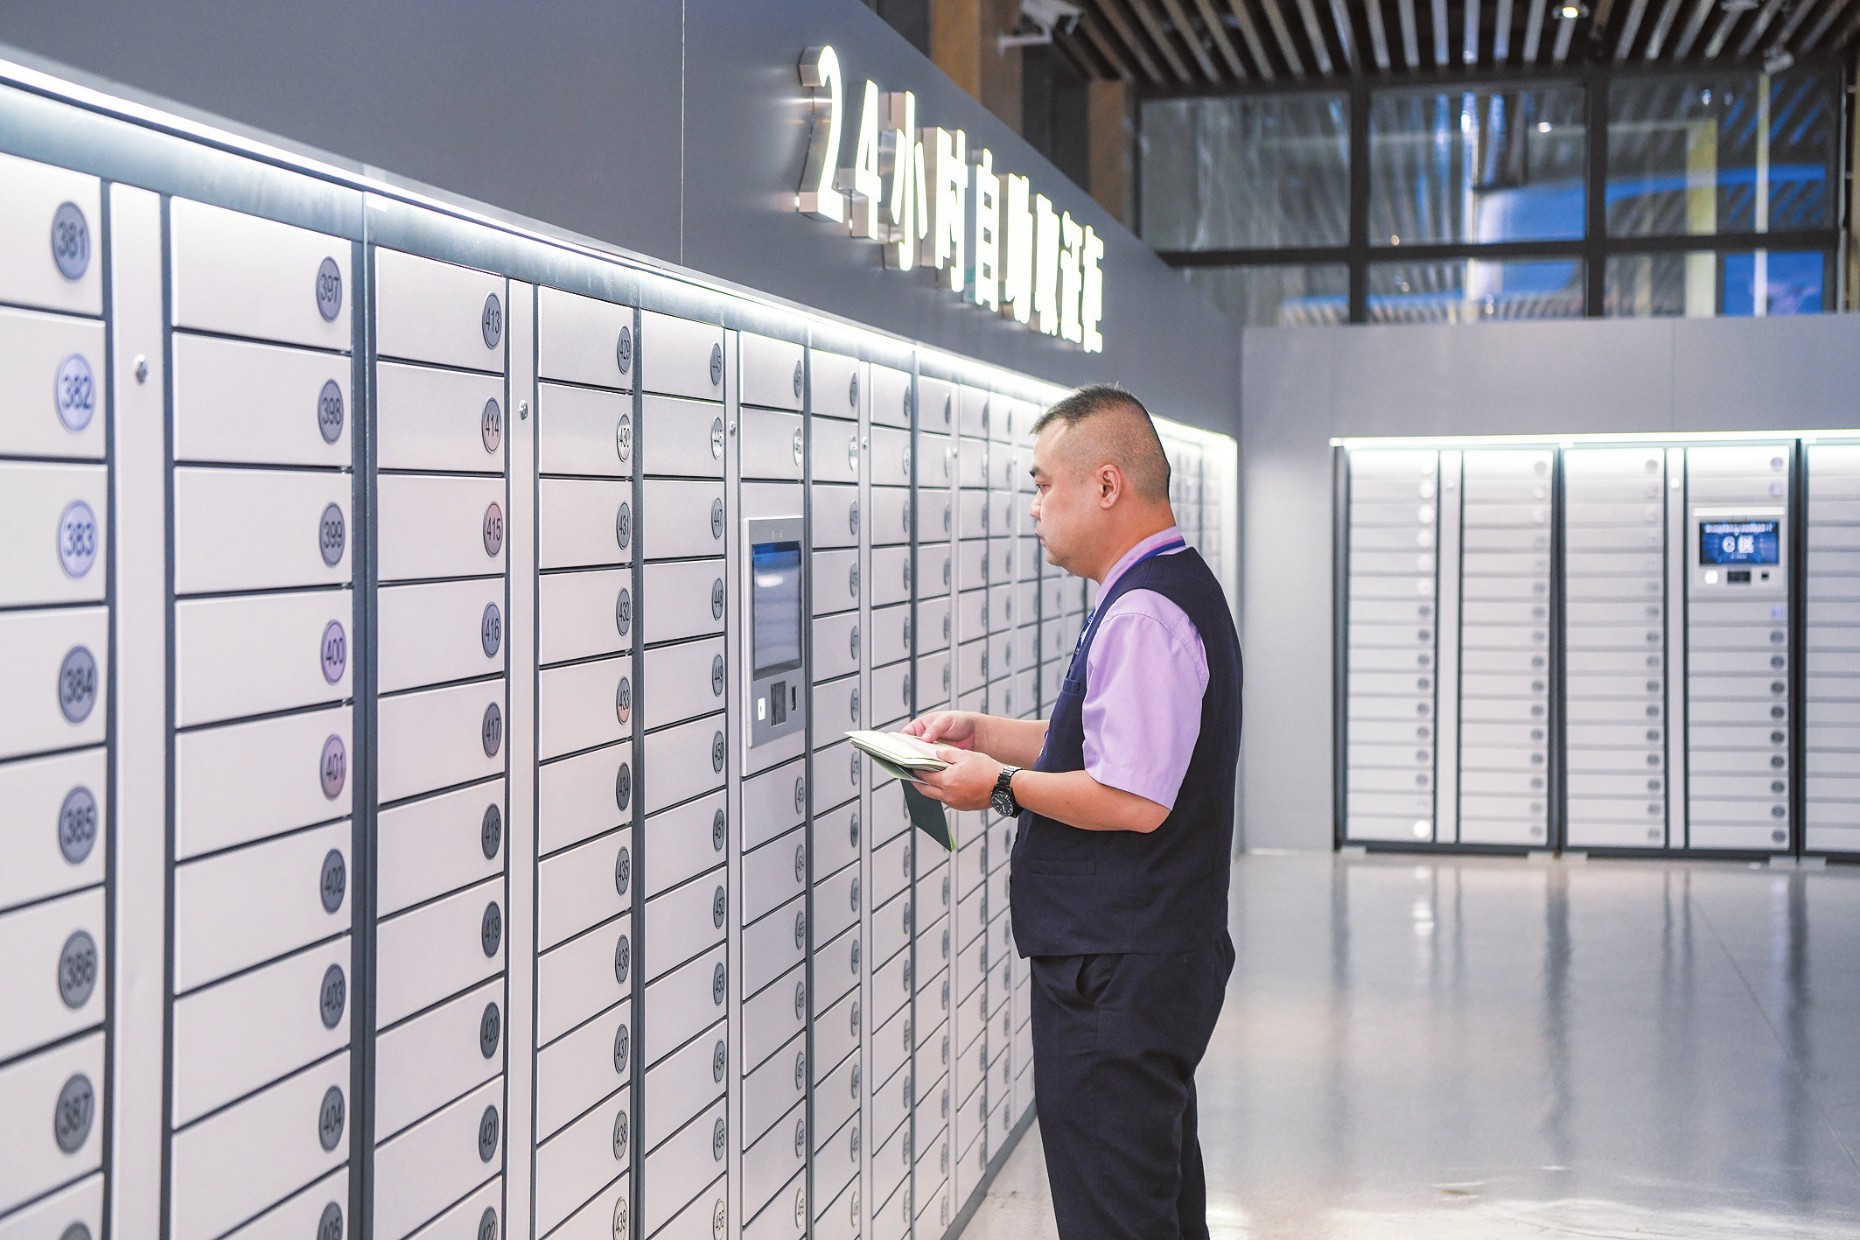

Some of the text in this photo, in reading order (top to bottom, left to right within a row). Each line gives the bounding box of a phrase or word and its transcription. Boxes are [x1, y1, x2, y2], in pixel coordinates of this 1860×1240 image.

[58, 221, 85, 260] 381
[321, 273, 339, 303] 397
[485, 307, 500, 334] 413
[619, 339, 630, 360] 429
[63, 376, 92, 410] 382
[323, 397, 341, 425] 398
[485, 413, 500, 438] 414
[619, 427, 630, 448] 430
[324, 521, 342, 548] 399
[486, 518, 501, 541] 415
[619, 515, 630, 536] 431
[67, 523, 92, 556] 383
[619, 601, 630, 622] 432
[485, 617, 500, 642] 416
[326, 637, 343, 666] 400
[66, 667, 93, 704] 384
[619, 689, 629, 710] 433
[485, 716, 500, 742] 417
[326, 751, 343, 781] 401
[618, 776, 629, 796] 434
[66, 808, 93, 845] 385
[485, 817, 499, 842] 418
[325, 866, 343, 895] 402
[618, 859, 629, 882] 435
[485, 914, 499, 942] 419
[66, 949, 92, 990] 386
[618, 947, 628, 970] 436
[325, 980, 342, 1010] 403
[484, 1016, 498, 1041] 420
[617, 1036, 628, 1060] 437
[61, 1091, 90, 1137] 387
[323, 1102, 342, 1134] 404
[482, 1121, 496, 1147] 421
[615, 1209, 626, 1233] 439
